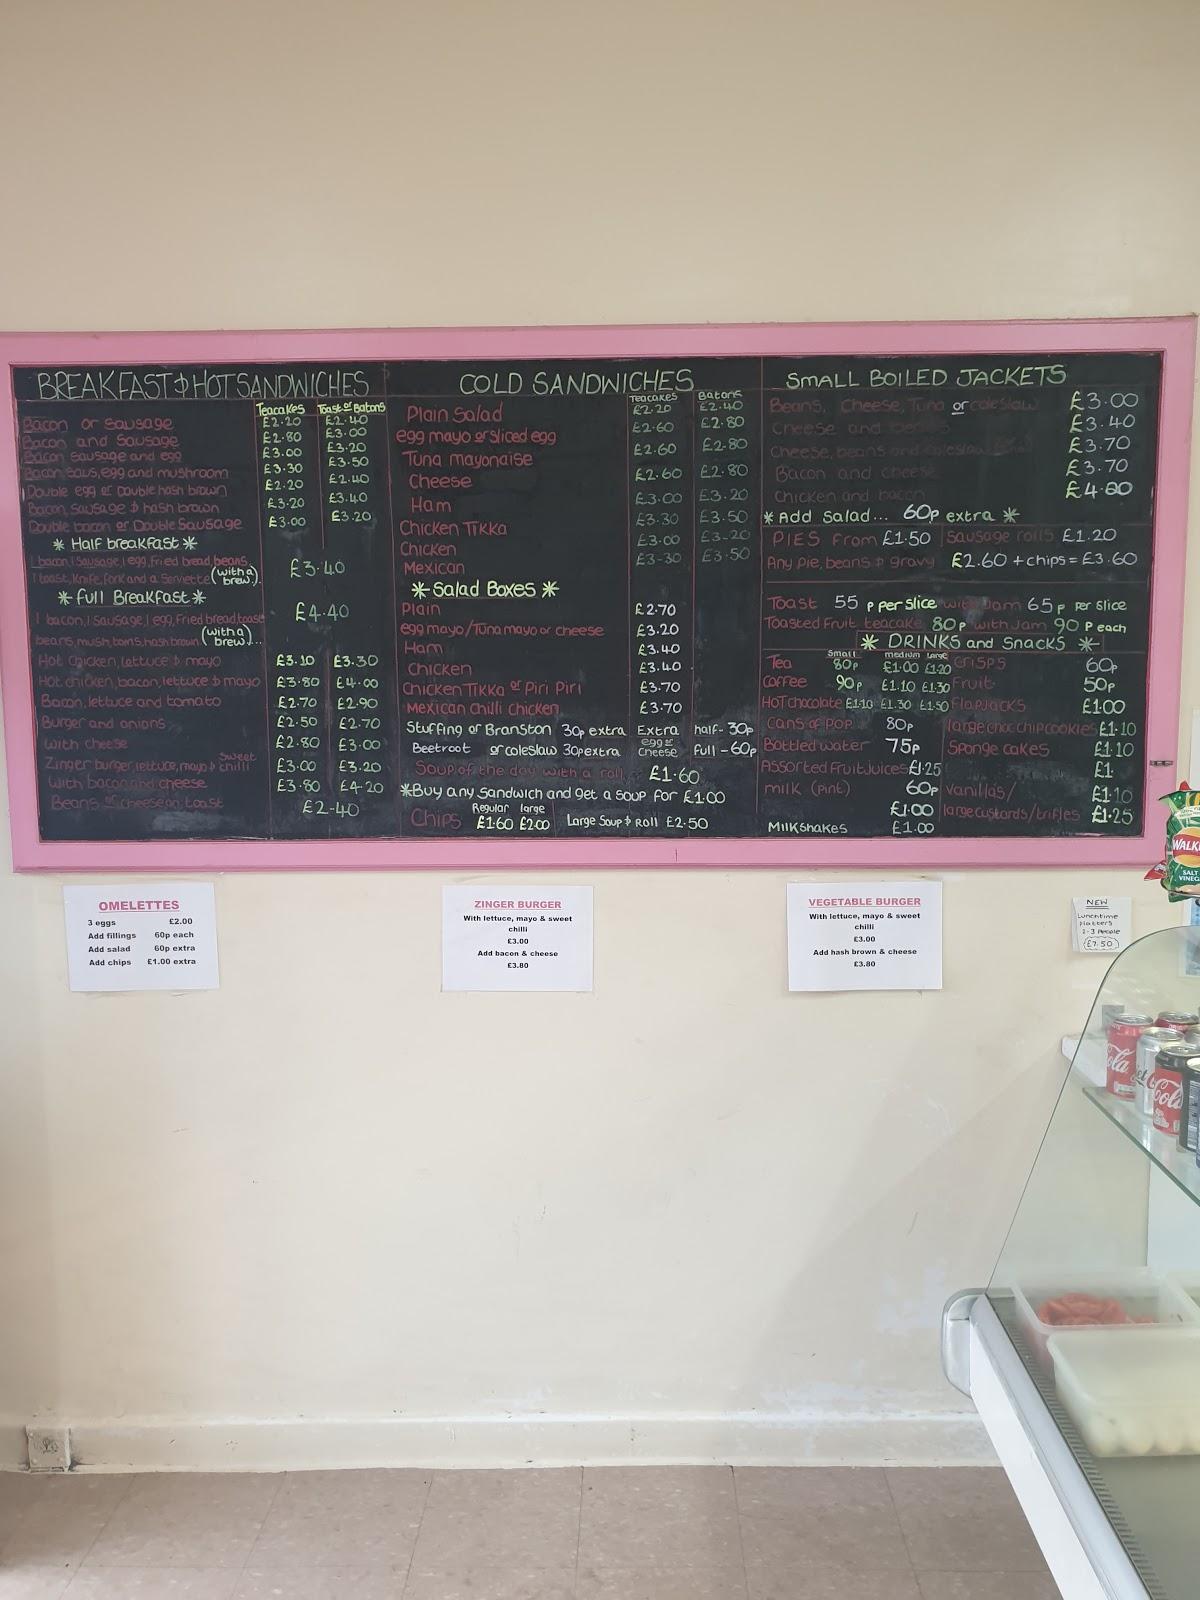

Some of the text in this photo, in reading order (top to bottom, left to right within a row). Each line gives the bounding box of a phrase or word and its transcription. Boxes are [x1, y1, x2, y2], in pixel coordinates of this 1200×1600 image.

[459, 368, 695, 395] COLD SANDWICHES
[870, 369, 948, 387] BOILED
[956, 364, 1067, 387] JACKETS
[38, 370, 173, 400] BREAKFAST
[193, 369, 236, 399] HOT
[237, 370, 370, 398] SANDWICHES
[1070, 390, 1138, 410] £3.00
[256, 402, 306, 417] Teacakes
[407, 405, 449, 423] Plain
[263, 416, 301, 428] £2.20
[325, 414, 369, 426] £2.40
[1069, 414, 1135, 433] £3.40
[263, 431, 302, 444] £2.80
[325, 428, 367, 439] £3.00
[429, 430, 471, 445] mayo
[530, 430, 557, 445] egg
[1069, 436, 1131, 453] £3.70
[402, 450, 442, 467] Tuna
[1066, 459, 1128, 476] £3.70
[409, 474, 473, 489] Cheese
[411, 496, 451, 513] Ham
[779, 509, 812, 524] Add
[903, 504, 940, 524] 60p
[946, 511, 996, 523] extra
[399, 519, 460, 537] Chicken
[1062, 528, 1117, 542] £1.20
[71, 536, 180, 551] Half breakfast
[883, 530, 931, 546] £1.50
[951, 552, 1007, 569] £2.60
[1082, 551, 1138, 566] £3.60
[290, 558, 346, 578] £3.40
[404, 561, 465, 575] Mexican
[432, 579, 536, 598] Salad Boxes
[113, 589, 191, 606] Breakfast
[767, 596, 818, 610] Toast
[834, 595, 859, 609] 55
[905, 595, 938, 611] slice
[295, 601, 349, 622] £4.40
[635, 603, 676, 616] £2.70
[636, 623, 679, 637] £3.20
[638, 643, 681, 656] £3.40
[888, 634, 1066, 651] DRINKS and Snacks
[276, 654, 315, 667] £3.10
[334, 654, 379, 667] £3.30
[766, 654, 792, 669] Tea
[833, 658, 859, 671] 80p
[883, 661, 919, 674] £1.00
[1085, 657, 1118, 674] 60p
[639, 680, 681, 693] £3.70
[1083, 677, 1116, 694] 50p
[406, 720, 463, 737] Stuffing
[485, 723, 551, 736] Branston
[561, 724, 585, 739] 30p
[589, 725, 626, 736] extra
[637, 724, 680, 736] Extra
[727, 722, 754, 736] 30p
[886, 716, 914, 732] 80p
[563, 743, 583, 758] 30p
[584, 748, 621, 757] extra
[694, 740, 757, 757] full 60p
[885, 738, 920, 755] 75p
[649, 764, 700, 785] £1.60
[412, 783, 443, 800] Buy
[446, 786, 475, 799] any
[546, 786, 572, 800] and
[575, 788, 598, 803] get
[604, 790, 611, 800] a
[683, 789, 726, 804] £1.00
[905, 779, 938, 796] 60p
[476, 815, 551, 831] £1.60 £2.00
[566, 814, 596, 828] Large
[599, 815, 622, 828] Soup
[666, 816, 709, 830] £2.50
[892, 820, 935, 835] £1.00
[99, 900, 180, 911] OMELETTES
[474, 900, 562, 909] ZINGER BURGER
[809, 897, 921, 906] VEGETABLE BURGER
[95, 920, 116, 928] eggs
[483, 915, 514, 923] lettuce,
[106, 932, 136, 940] fillings
[154, 945, 171, 953] 60p
[107, 959, 132, 967] chips
